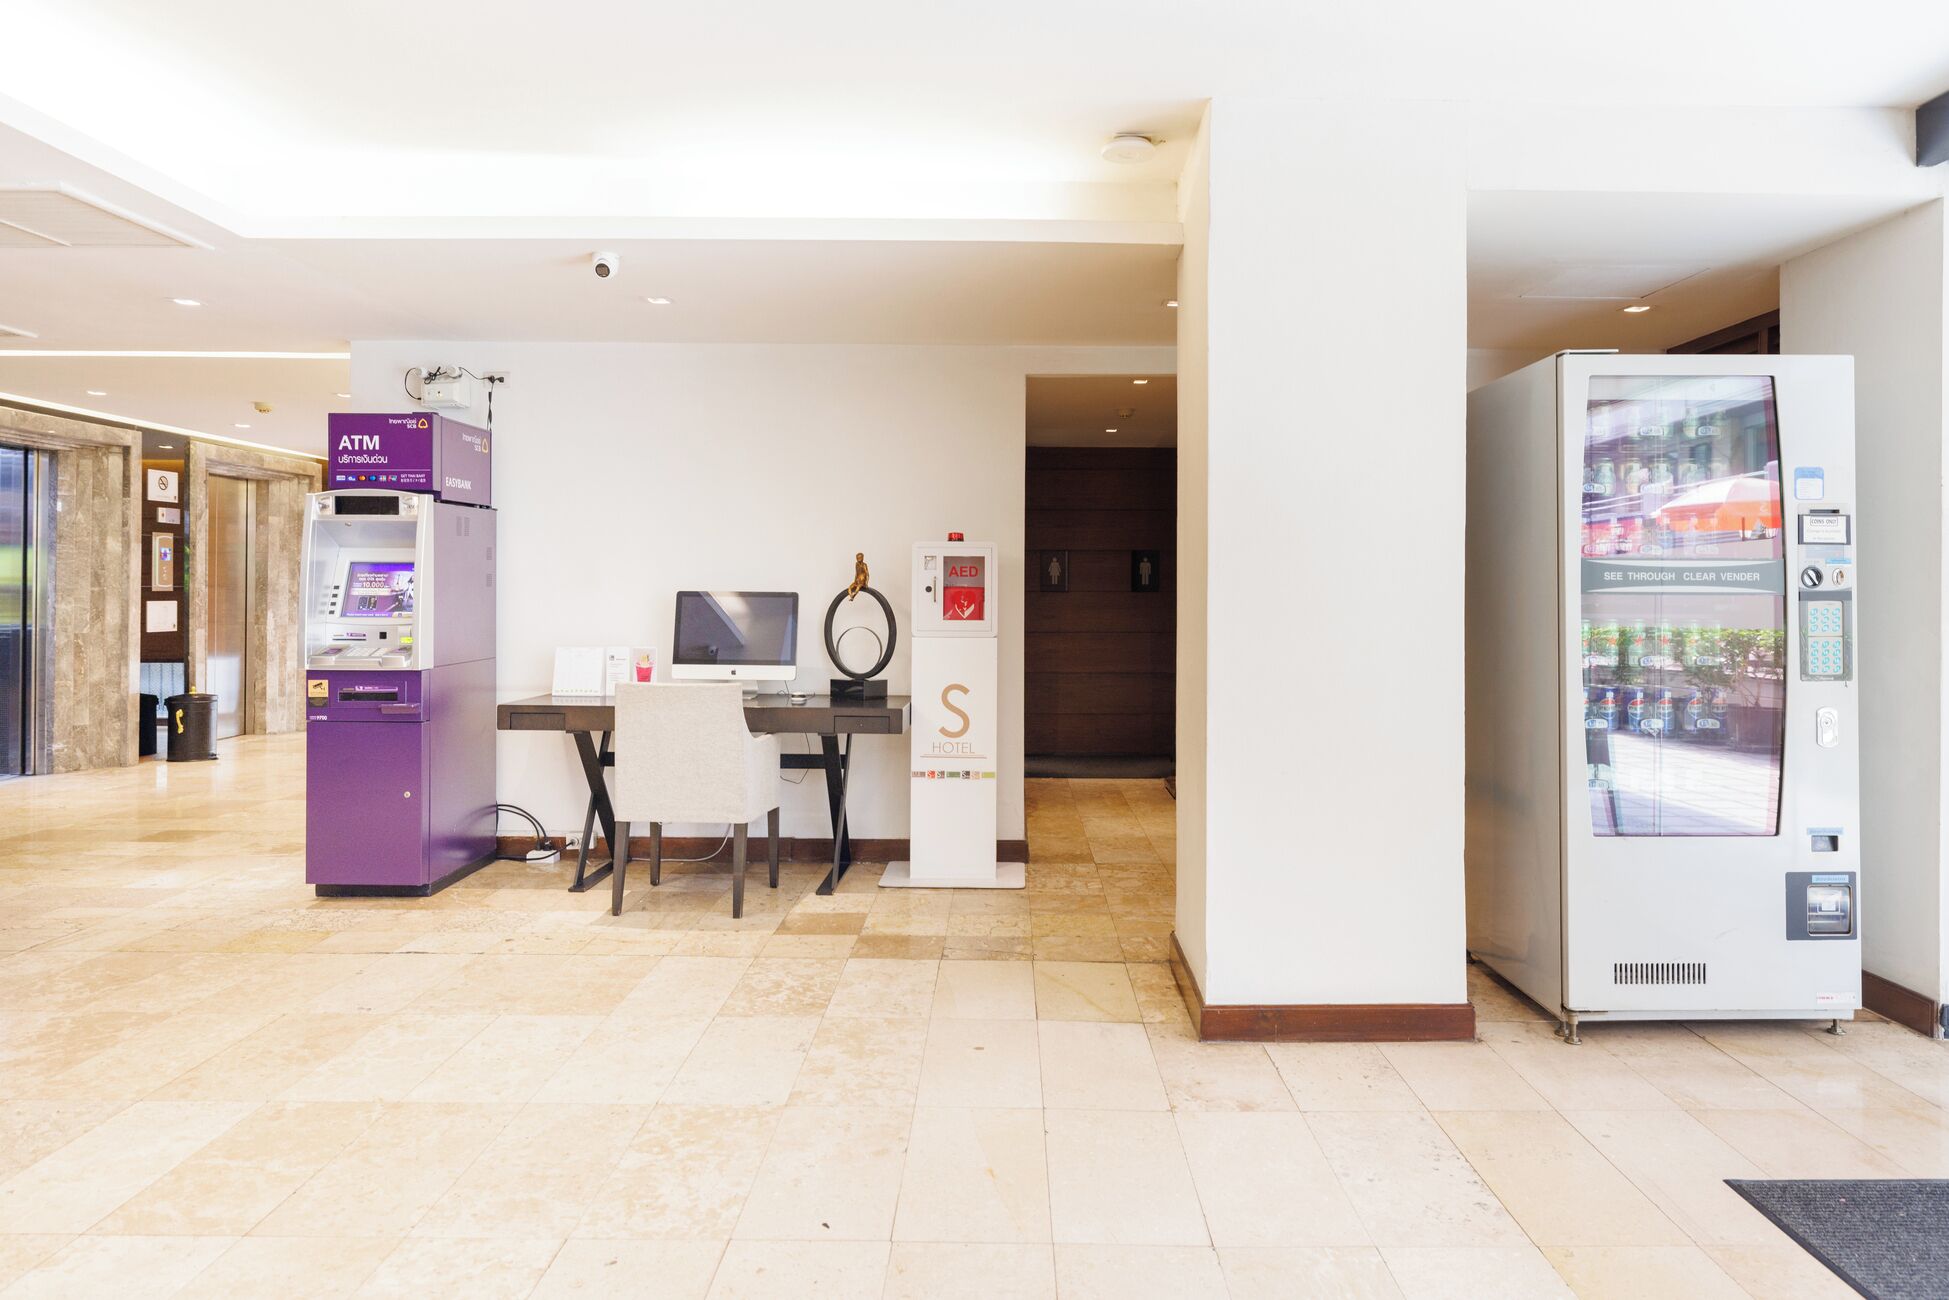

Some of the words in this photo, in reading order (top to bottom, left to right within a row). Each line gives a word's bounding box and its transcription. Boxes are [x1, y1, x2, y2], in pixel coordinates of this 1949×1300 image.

[338, 435, 380, 451] ATM
[338, 454, 388, 464] บริการเงินด่วน
[446, 477, 472, 490] EASYBANK
[948, 565, 979, 577] AED
[1603, 571, 1623, 581] SEE
[1627, 571, 1676, 581] THROUGH
[1683, 571, 1716, 581] CLEAR
[1720, 571, 1760, 582] VENDER
[939, 683, 970, 738] S
[932, 741, 975, 754] HOTEL
